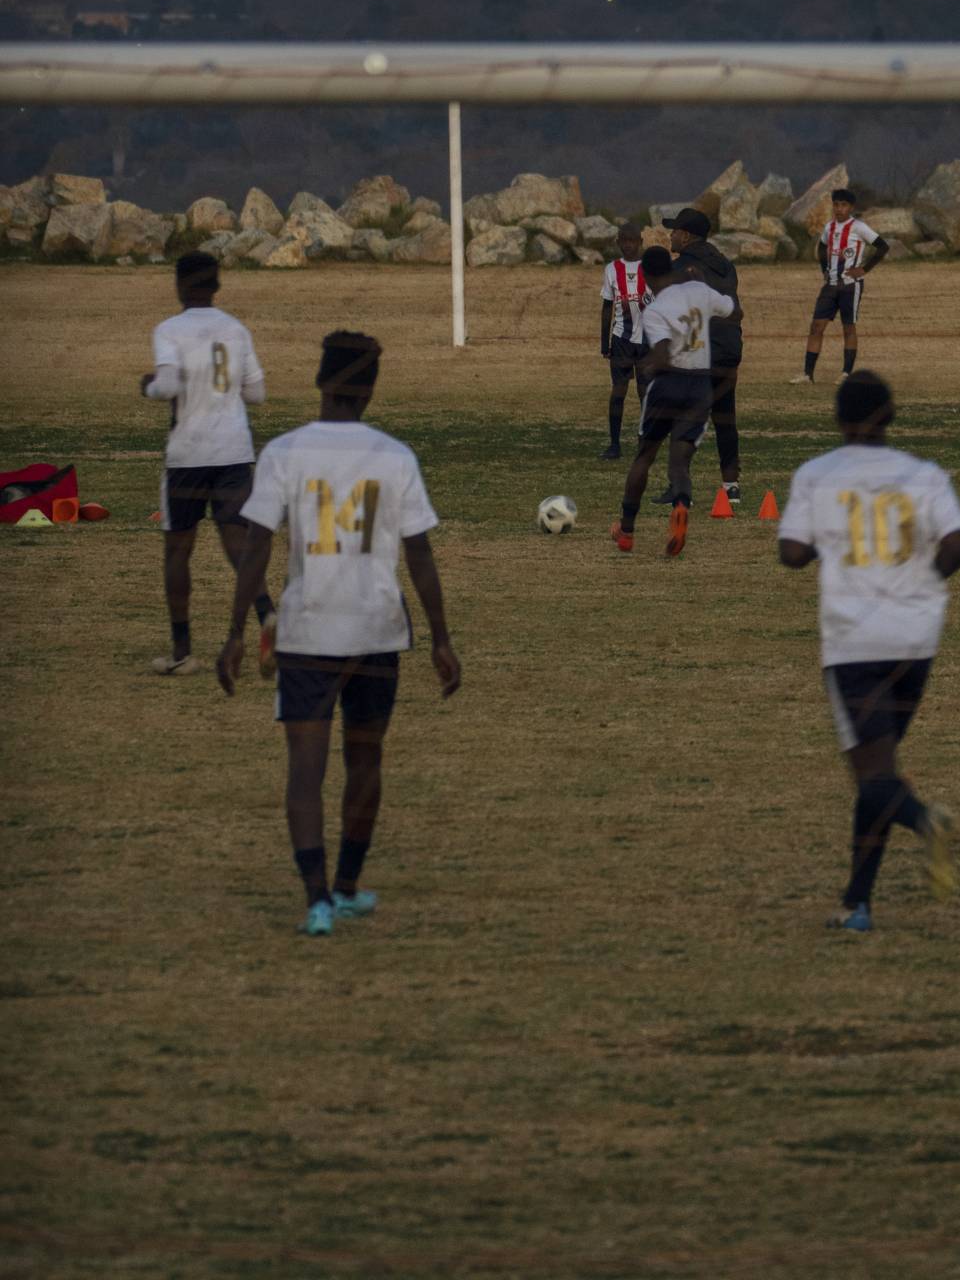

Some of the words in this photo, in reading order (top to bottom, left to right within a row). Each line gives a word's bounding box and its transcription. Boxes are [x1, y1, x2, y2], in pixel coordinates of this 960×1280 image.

[213, 342, 229, 393] 8
[306, 479, 379, 555] 14
[837, 489, 914, 567] 10
